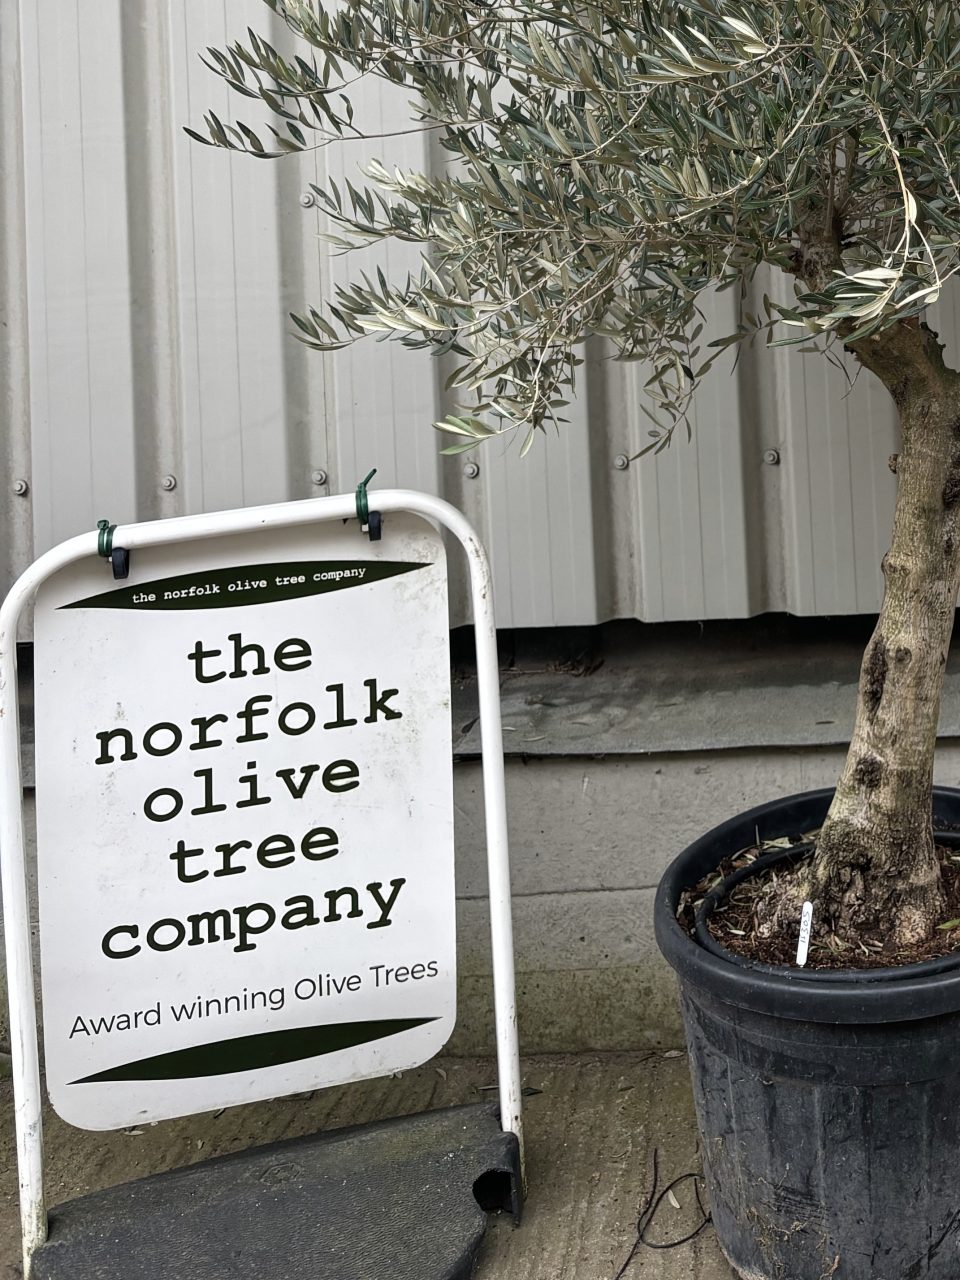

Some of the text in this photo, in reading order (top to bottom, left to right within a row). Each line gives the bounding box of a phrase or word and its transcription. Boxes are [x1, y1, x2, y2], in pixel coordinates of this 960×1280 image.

[132, 567, 366, 604] the norfolk olive tree company
[187, 632, 312, 684] the
[94, 678, 403, 766] norfolk
[143, 759, 360, 823] olive
[169, 826, 339, 884] tree
[101, 877, 407, 960] company
[68, 959, 439, 1039] Award winning Olive Trees
